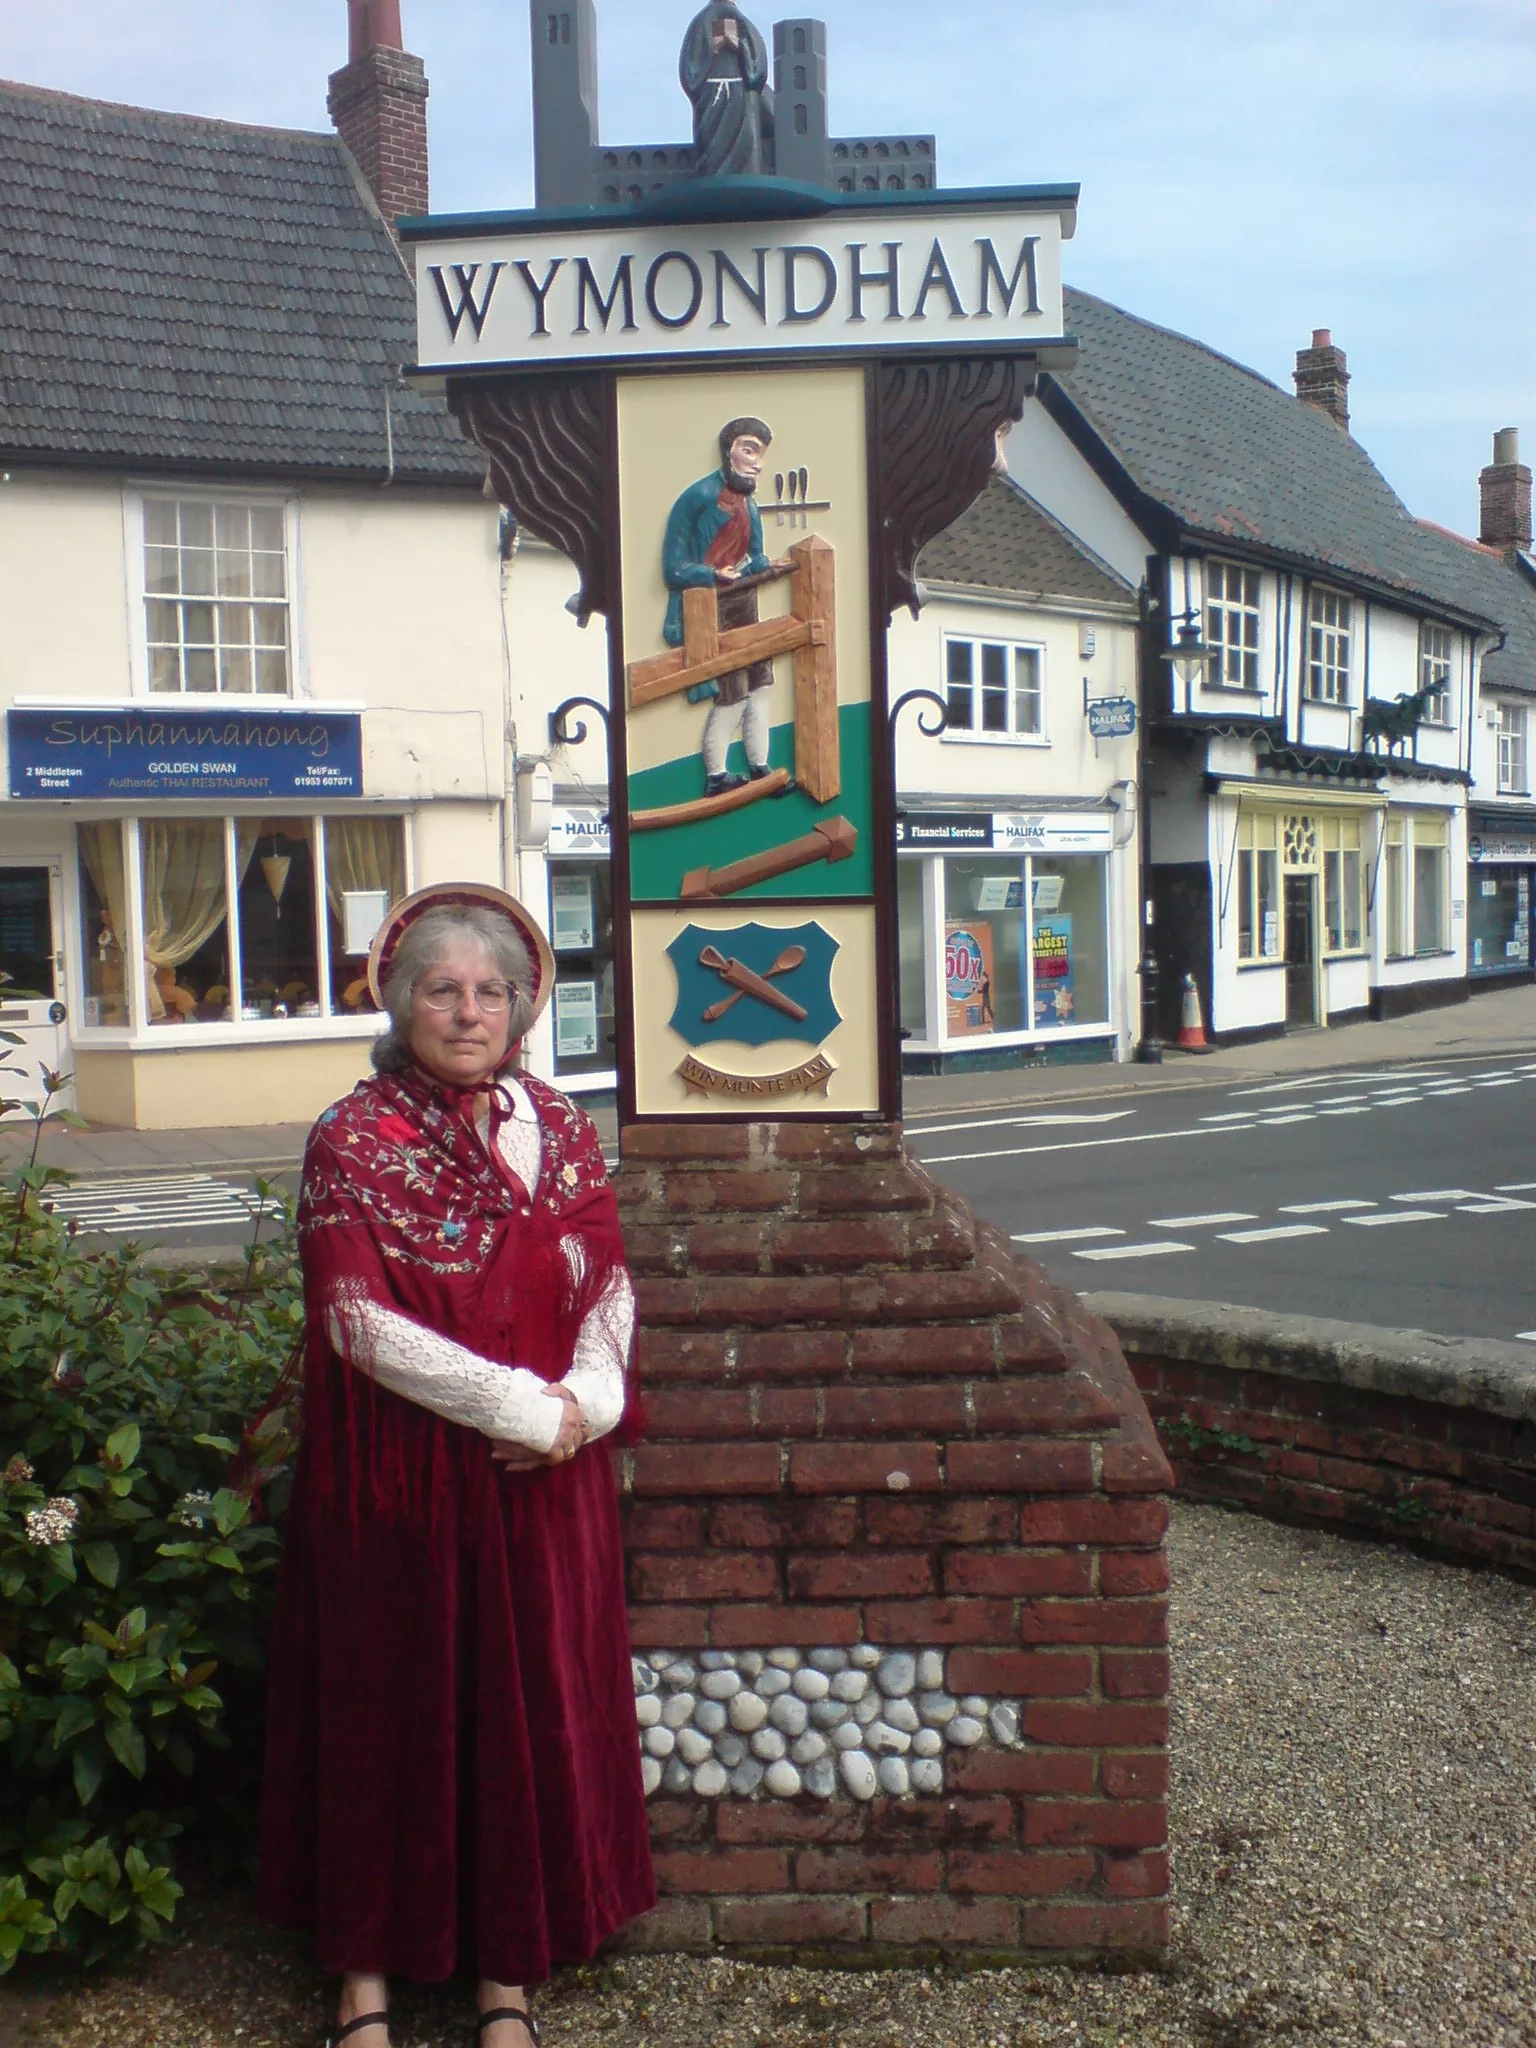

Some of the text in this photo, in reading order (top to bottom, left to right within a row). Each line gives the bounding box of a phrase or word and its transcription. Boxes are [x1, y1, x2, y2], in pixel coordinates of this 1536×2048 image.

[426, 235, 1043, 344] WYMONDHAM
[45, 720, 330, 758] Suphannahong
[26, 767, 83, 777] 2 Middleton
[148, 762, 237, 774] GOLDEN SWAN
[40, 778, 70, 788] Street
[108, 777, 271, 789] Authentic THAI RESTAURANT
[911, 826, 950, 838] Financial
[951, 826, 985, 838] Services
[1006, 826, 1046, 838] HALIFAX
[684, 1060, 717, 1087] WIN
[789, 1058, 830, 1087] HAM
